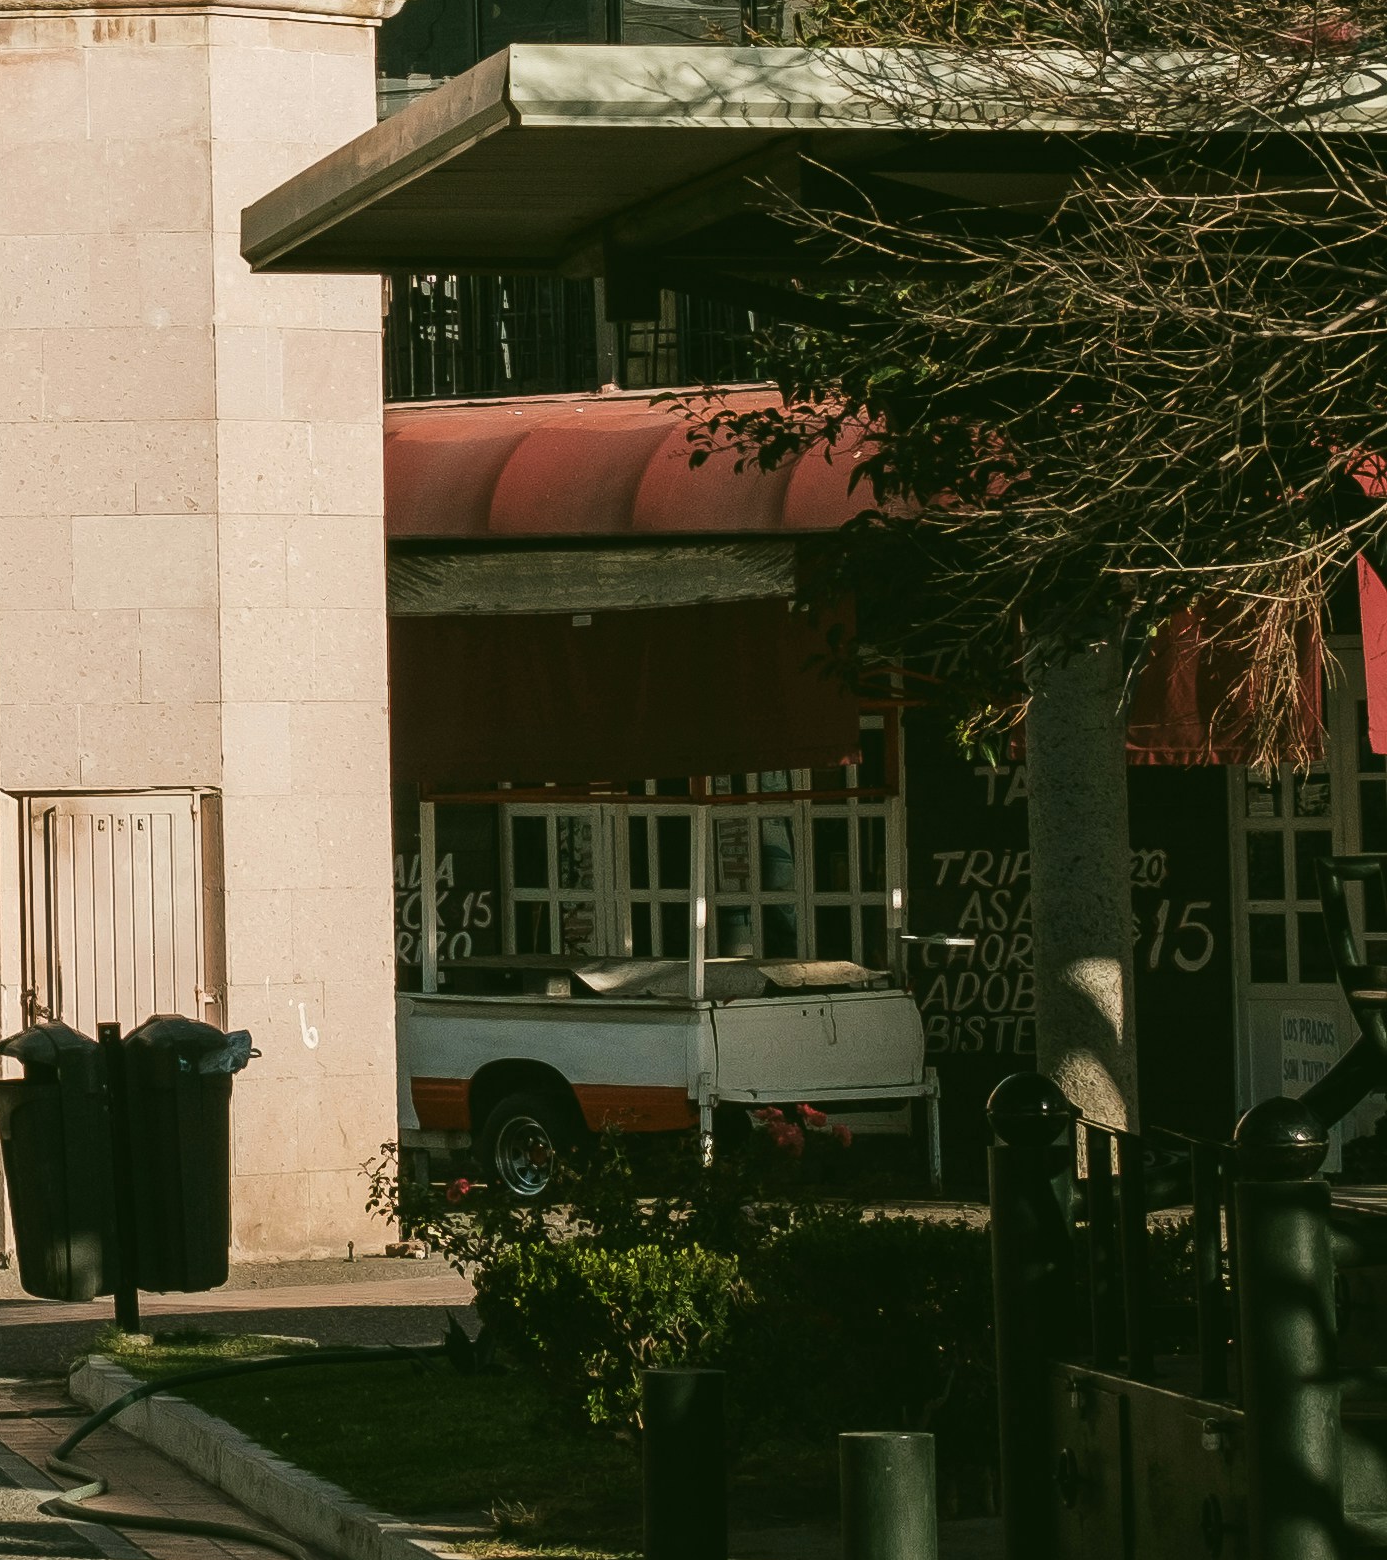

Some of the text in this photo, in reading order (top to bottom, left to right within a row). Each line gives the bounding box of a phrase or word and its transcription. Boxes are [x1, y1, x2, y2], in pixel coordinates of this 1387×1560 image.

[974, 765, 1028, 807] TA
[462, 889, 493, 930] 15
[957, 889, 1033, 931] ASA
[1149, 898, 1216, 973] 15
[921, 932, 1035, 974] CHOR
[920, 972, 1037, 1014] ADOB
